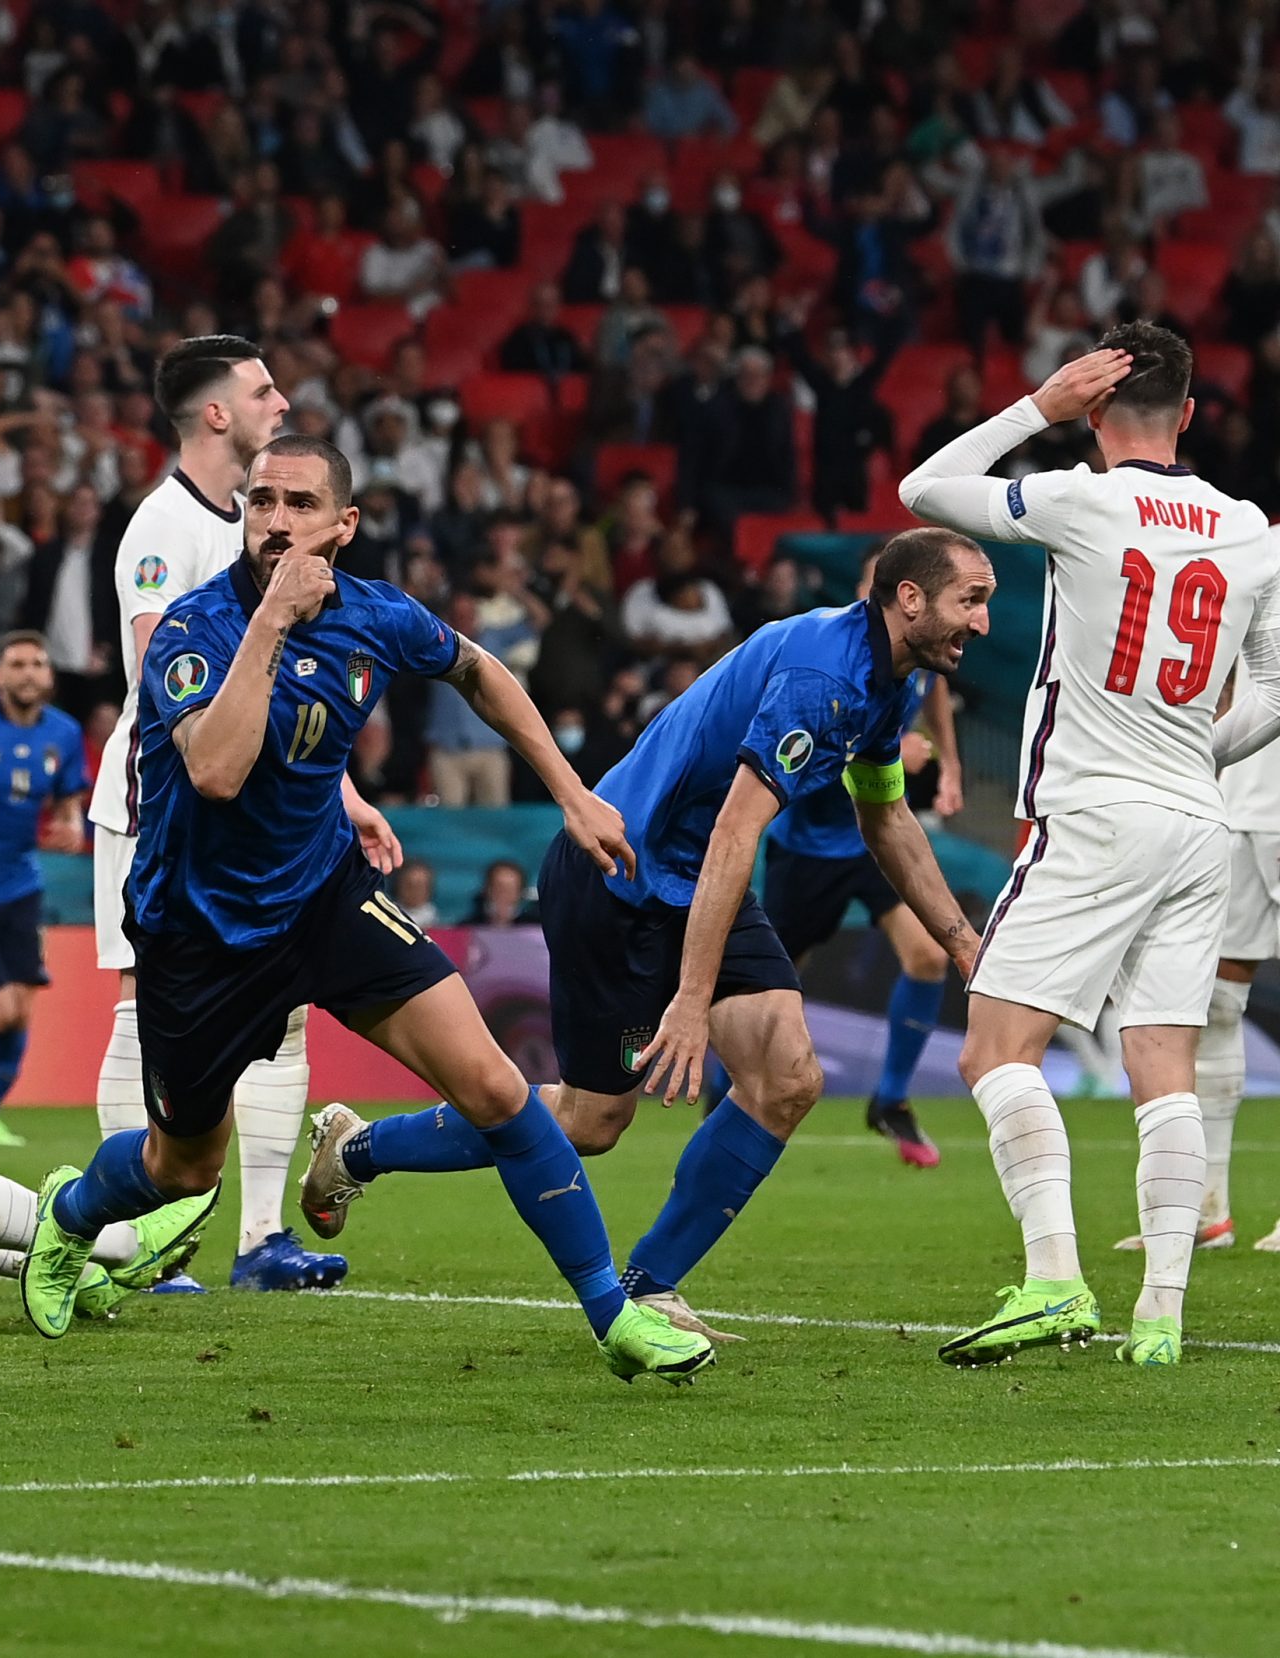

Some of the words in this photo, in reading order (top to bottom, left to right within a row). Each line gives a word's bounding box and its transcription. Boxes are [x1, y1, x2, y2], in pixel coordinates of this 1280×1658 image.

[1134, 495, 1221, 540] MOUNT
[1104, 547, 1228, 706] 19
[287, 701, 328, 764] 19
[868, 775, 902, 790] RESPEC
[360, 890, 423, 946] 19
